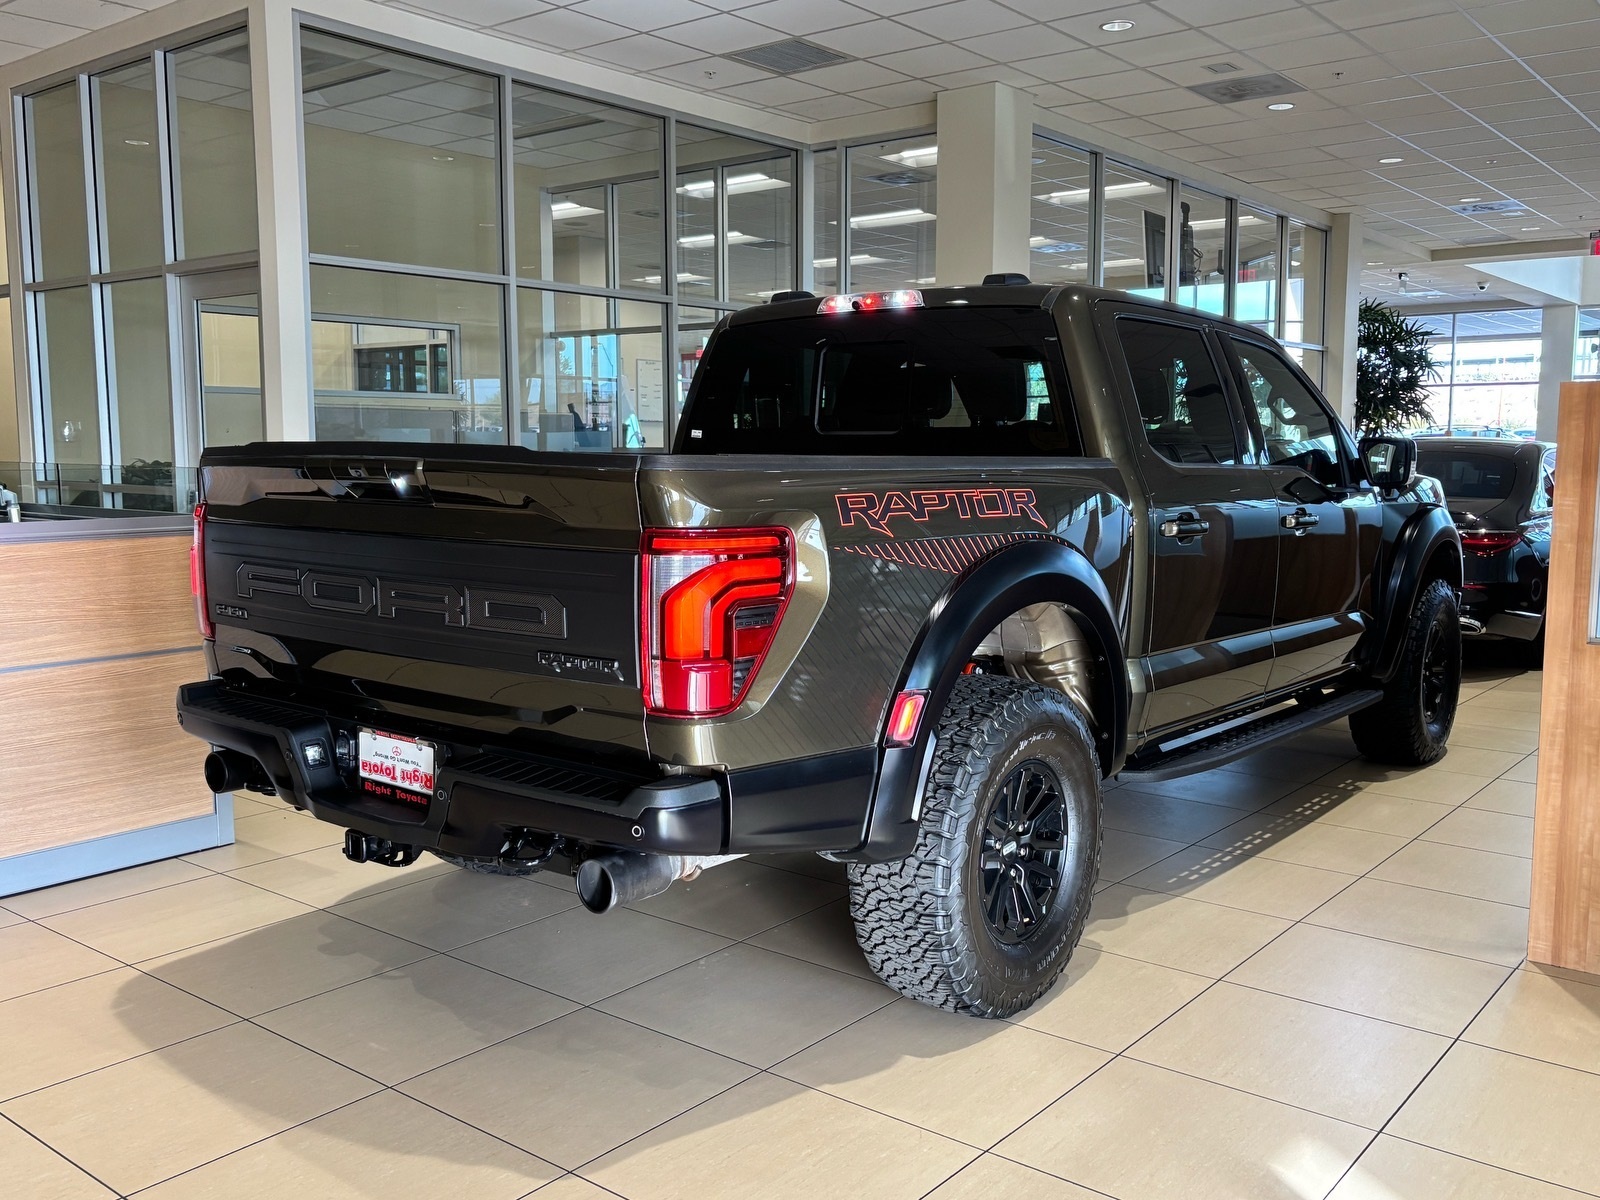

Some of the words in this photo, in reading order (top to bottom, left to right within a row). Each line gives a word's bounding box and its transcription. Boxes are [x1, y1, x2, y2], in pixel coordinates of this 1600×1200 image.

[835, 489, 1049, 537] RAPTOR
[236, 561, 568, 640] FORD
[537, 650, 624, 681] RAPTOR
[361, 760, 398, 782] Toyota
[400, 768, 434, 791] Right
[364, 781, 391, 794] Right
[396, 789, 428, 805] Toyota
